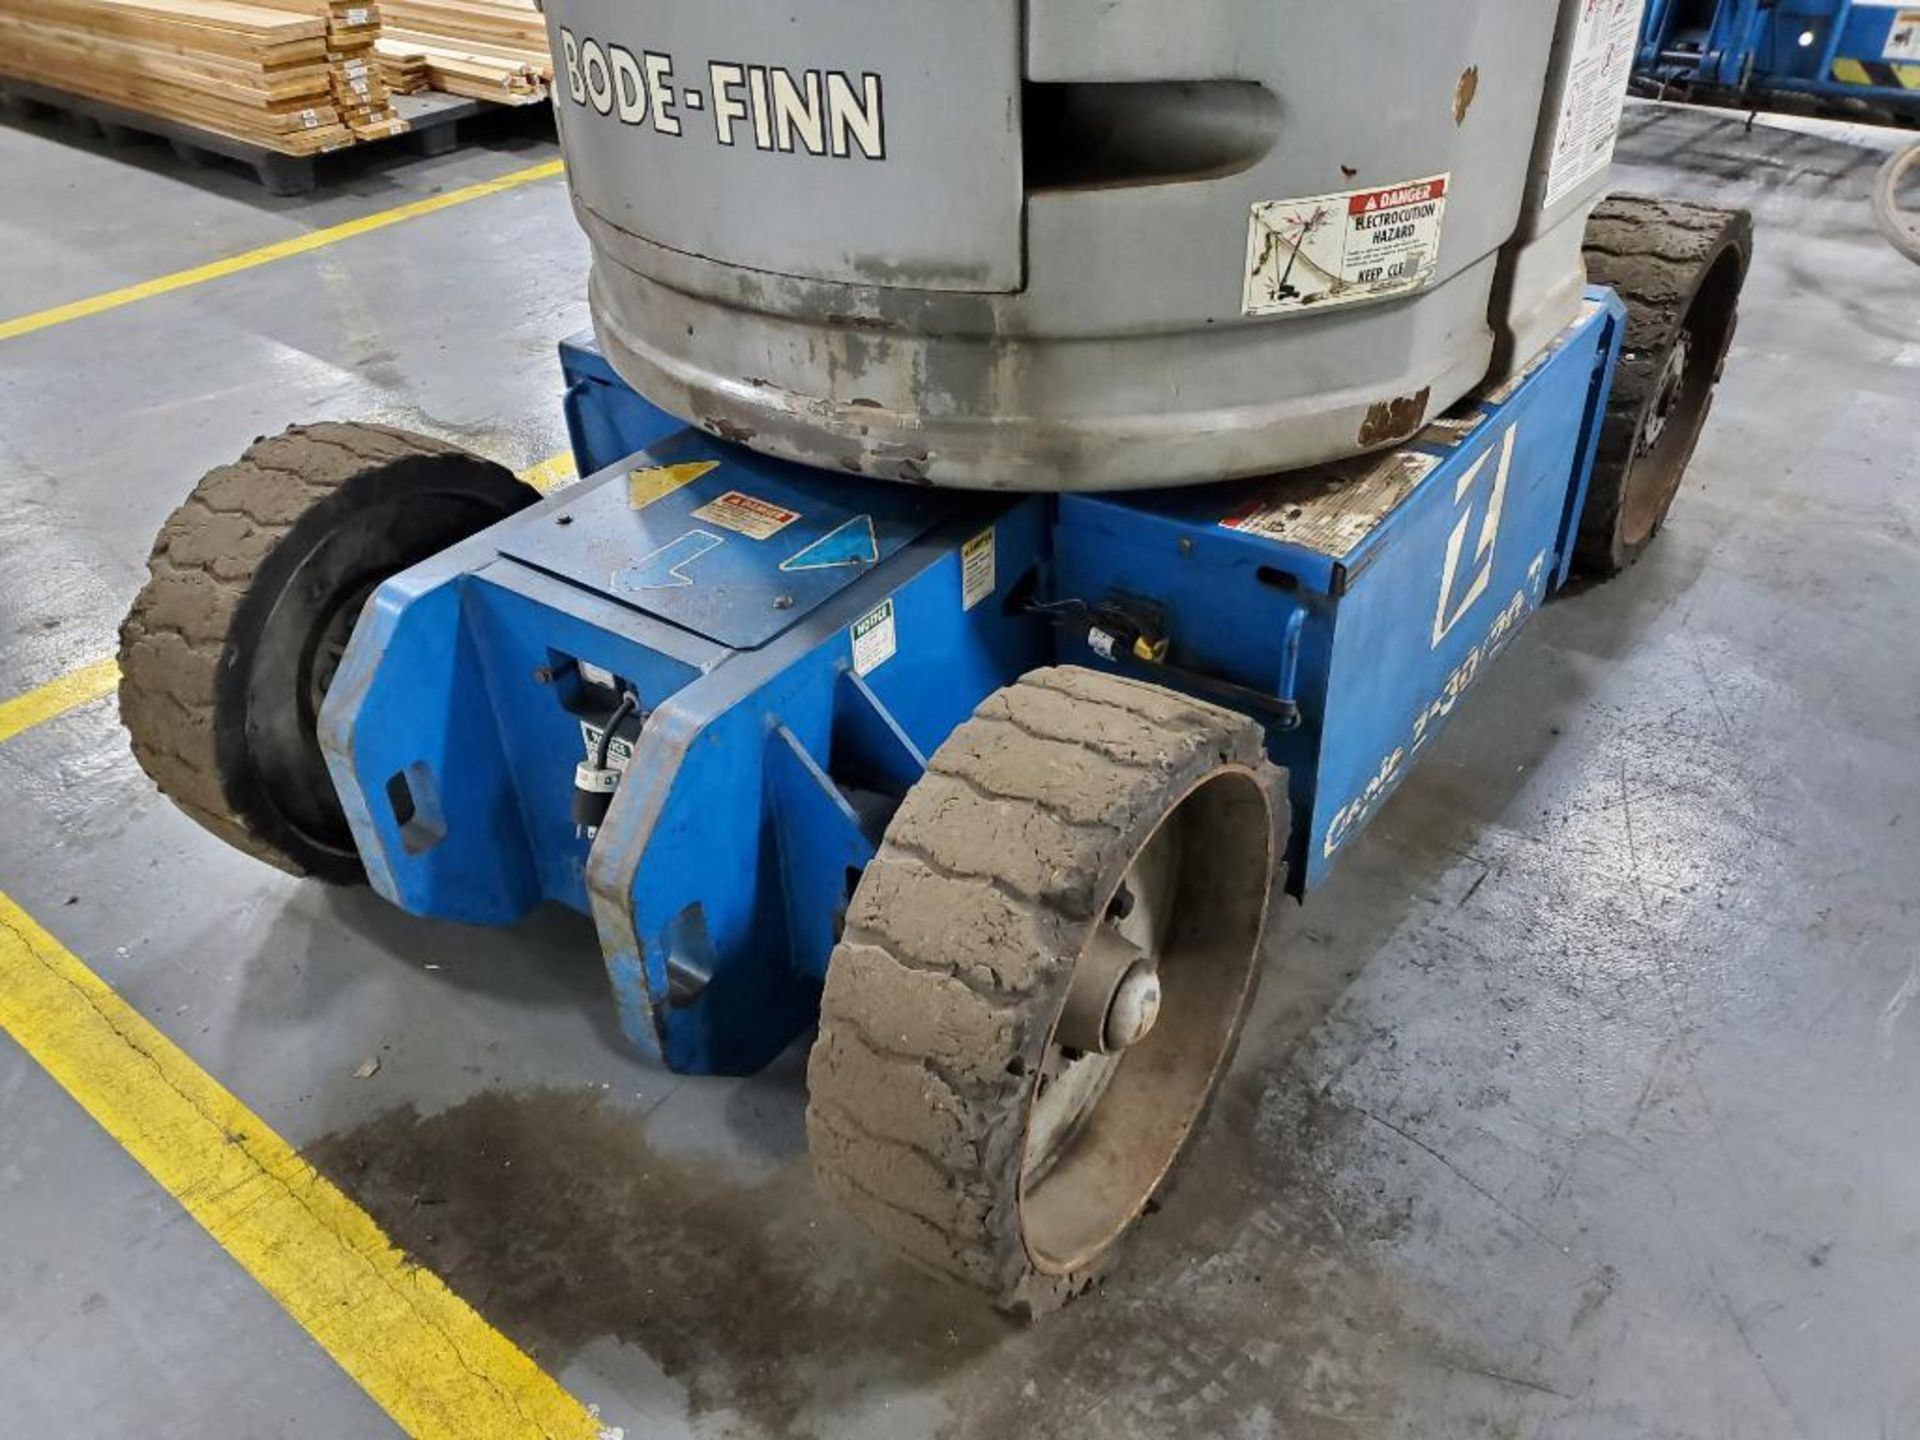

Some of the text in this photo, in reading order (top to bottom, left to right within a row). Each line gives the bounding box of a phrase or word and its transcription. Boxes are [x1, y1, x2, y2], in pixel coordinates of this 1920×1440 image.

[560, 25, 886, 160] BODE-FINN
[1380, 185, 1431, 209] DANGER
[1355, 203, 1435, 231] ELECTROCUTION
[1372, 224, 1416, 245] HAZARD
[1357, 267, 1383, 284] KEEP
